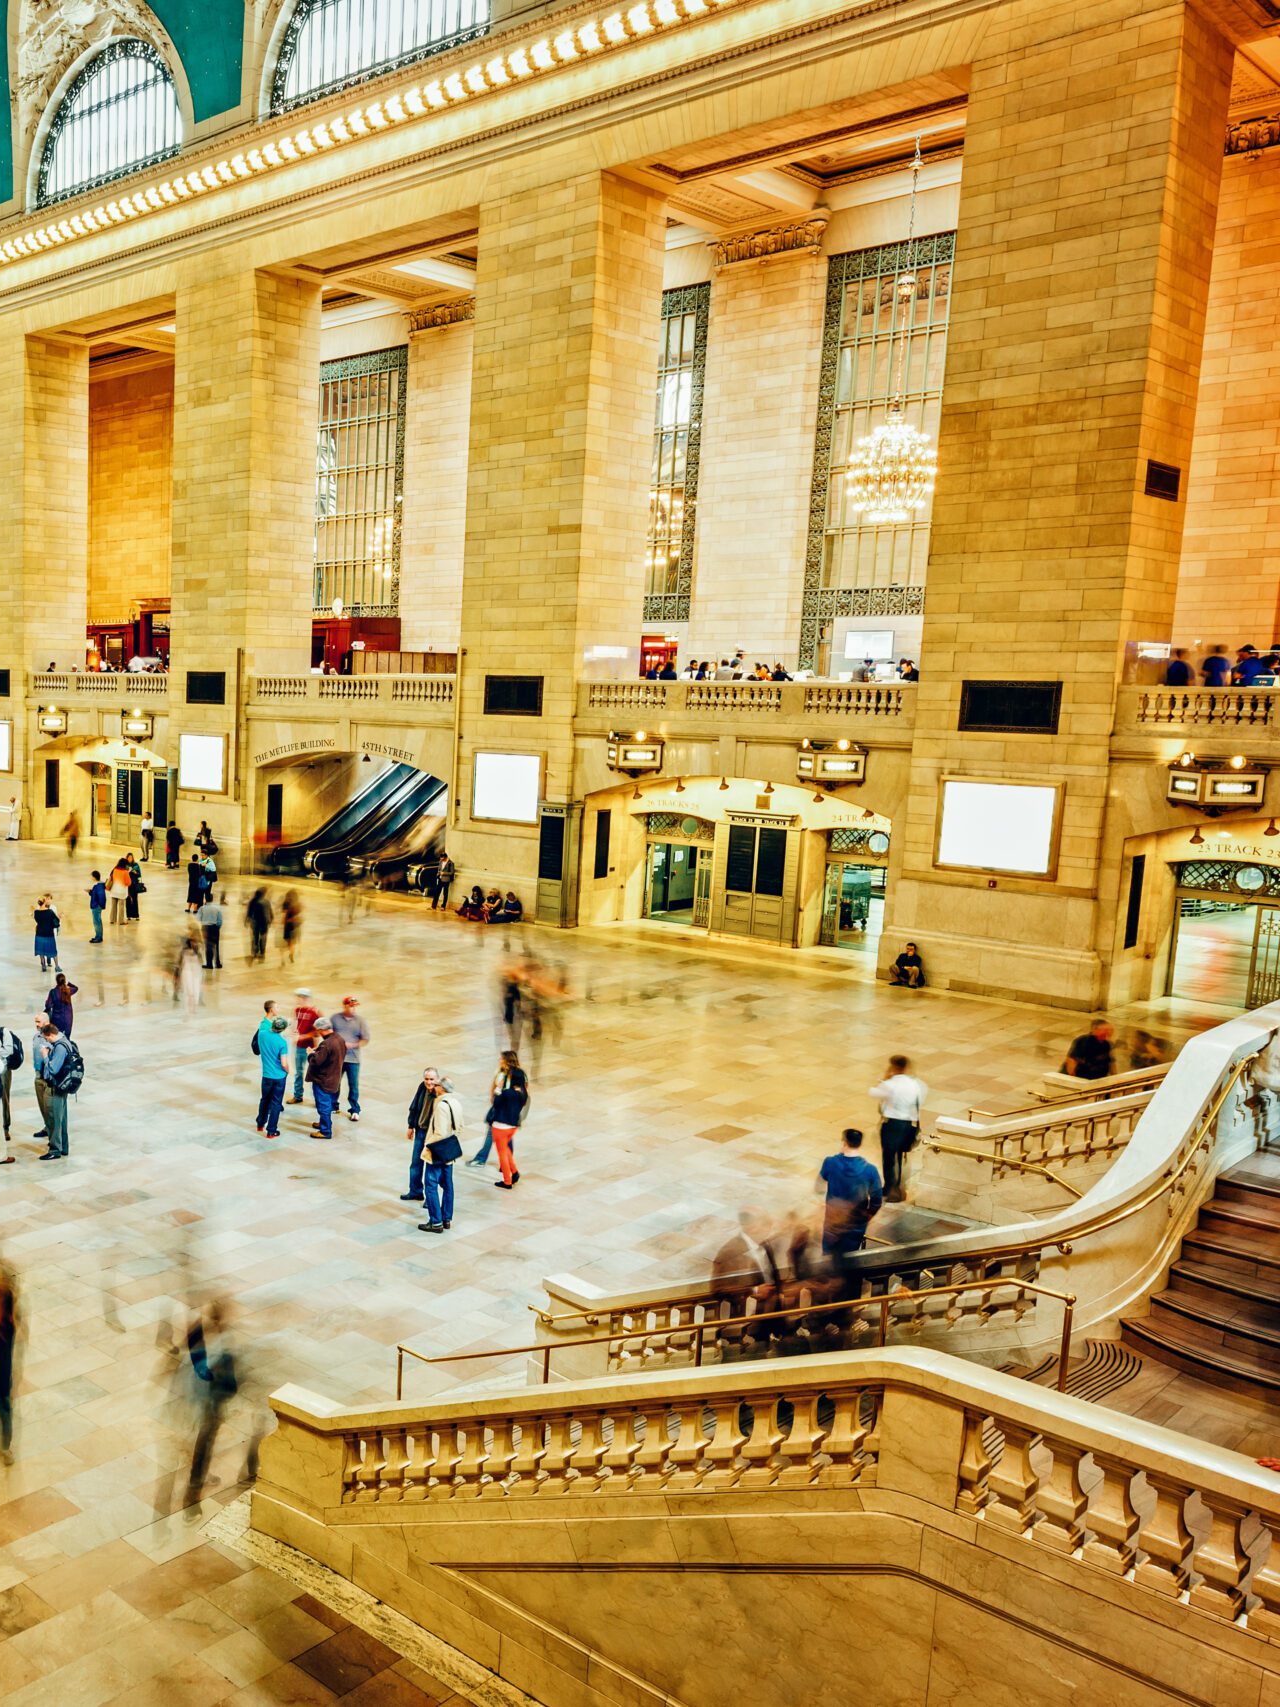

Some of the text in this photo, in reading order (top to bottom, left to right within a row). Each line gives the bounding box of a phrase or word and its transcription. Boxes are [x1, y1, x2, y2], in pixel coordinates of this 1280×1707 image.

[254, 739, 335, 763] THE METLIFE BUILDING
[362, 741, 414, 761] 45TH STREET
[658, 799, 689, 808] TRACKS
[1198, 843, 1211, 853] 23
[1215, 843, 1262, 856] TRACK
